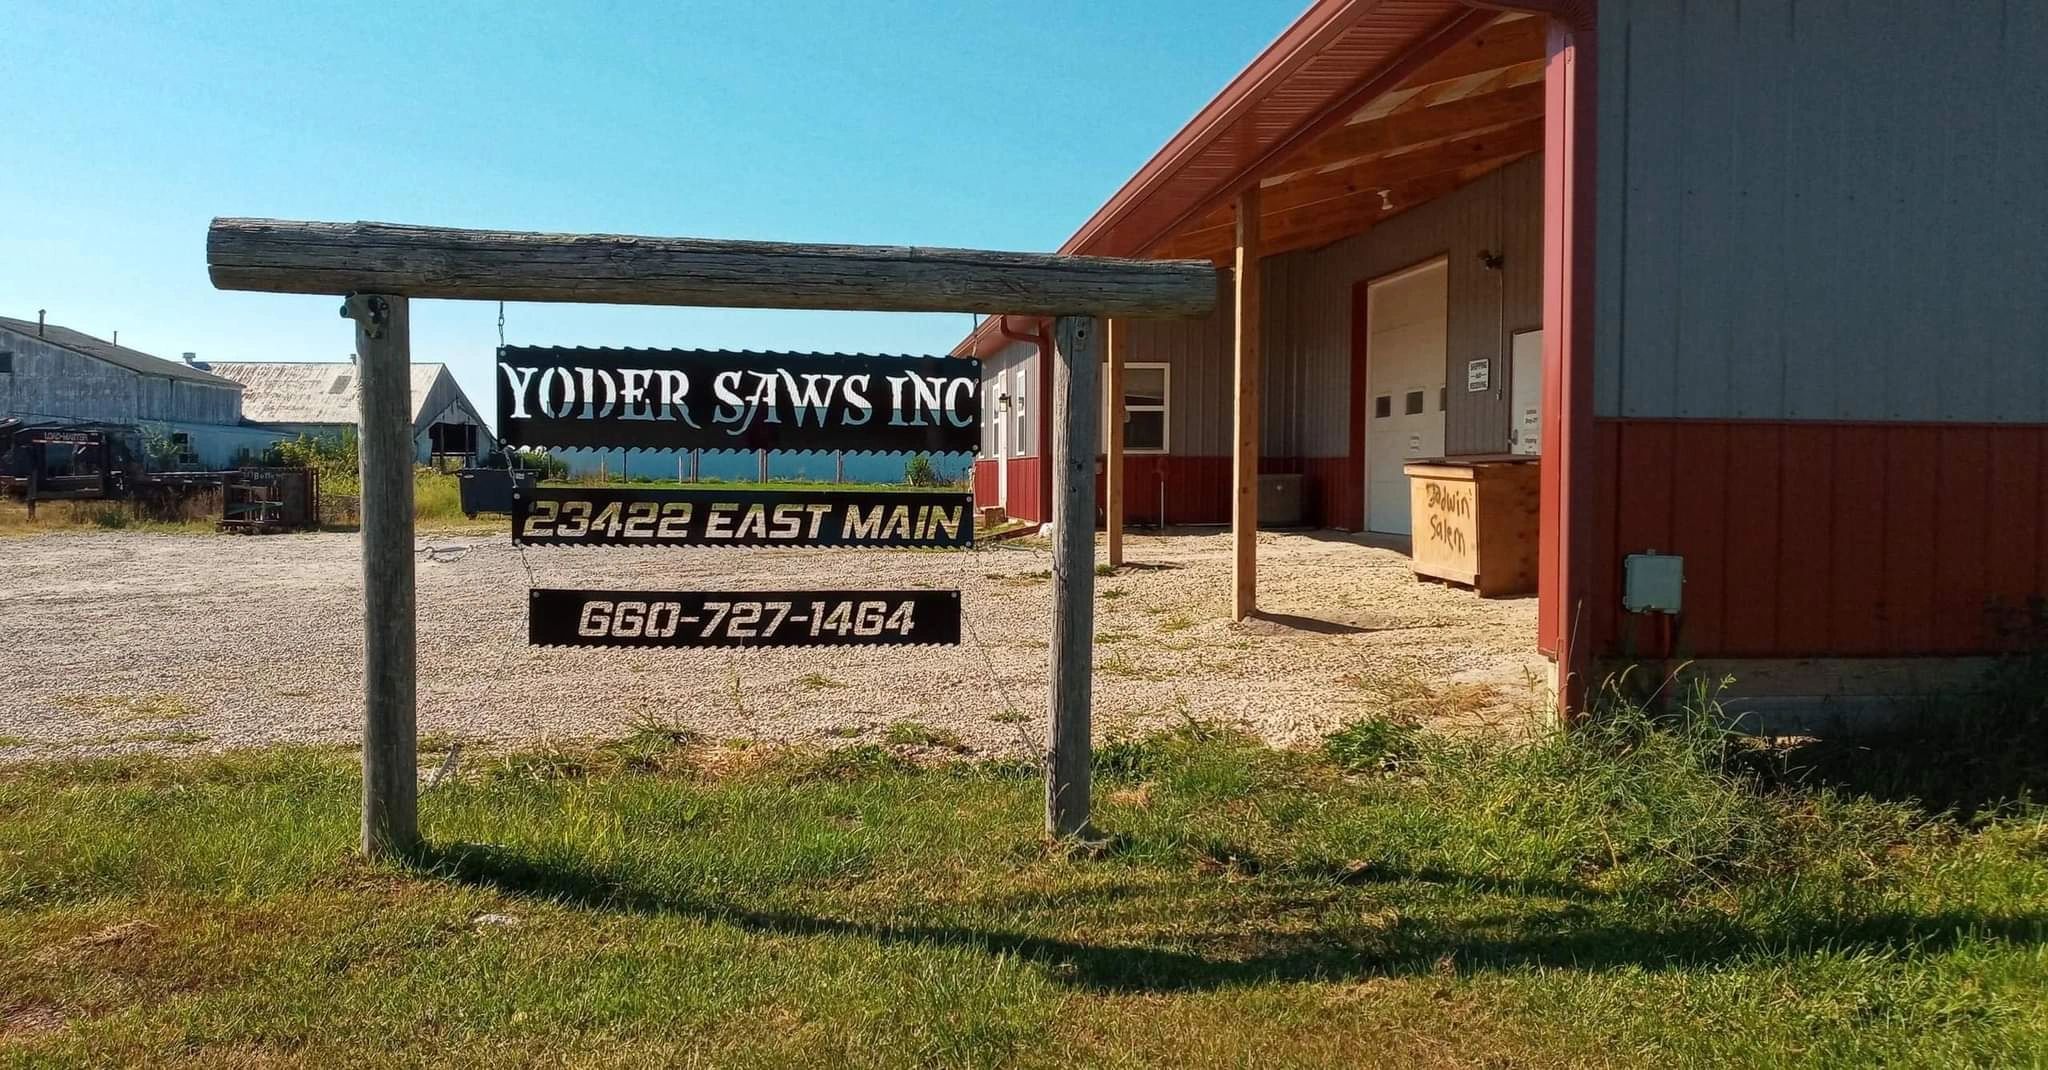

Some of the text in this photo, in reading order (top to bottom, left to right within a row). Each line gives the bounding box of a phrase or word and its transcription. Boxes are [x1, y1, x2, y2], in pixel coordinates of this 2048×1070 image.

[499, 362, 978, 436] YODER SAWS INC
[522, 500, 964, 541] 23422 EAST MAIN
[1430, 514, 1466, 557] Salem
[578, 600, 916, 638] 660-727-1464
